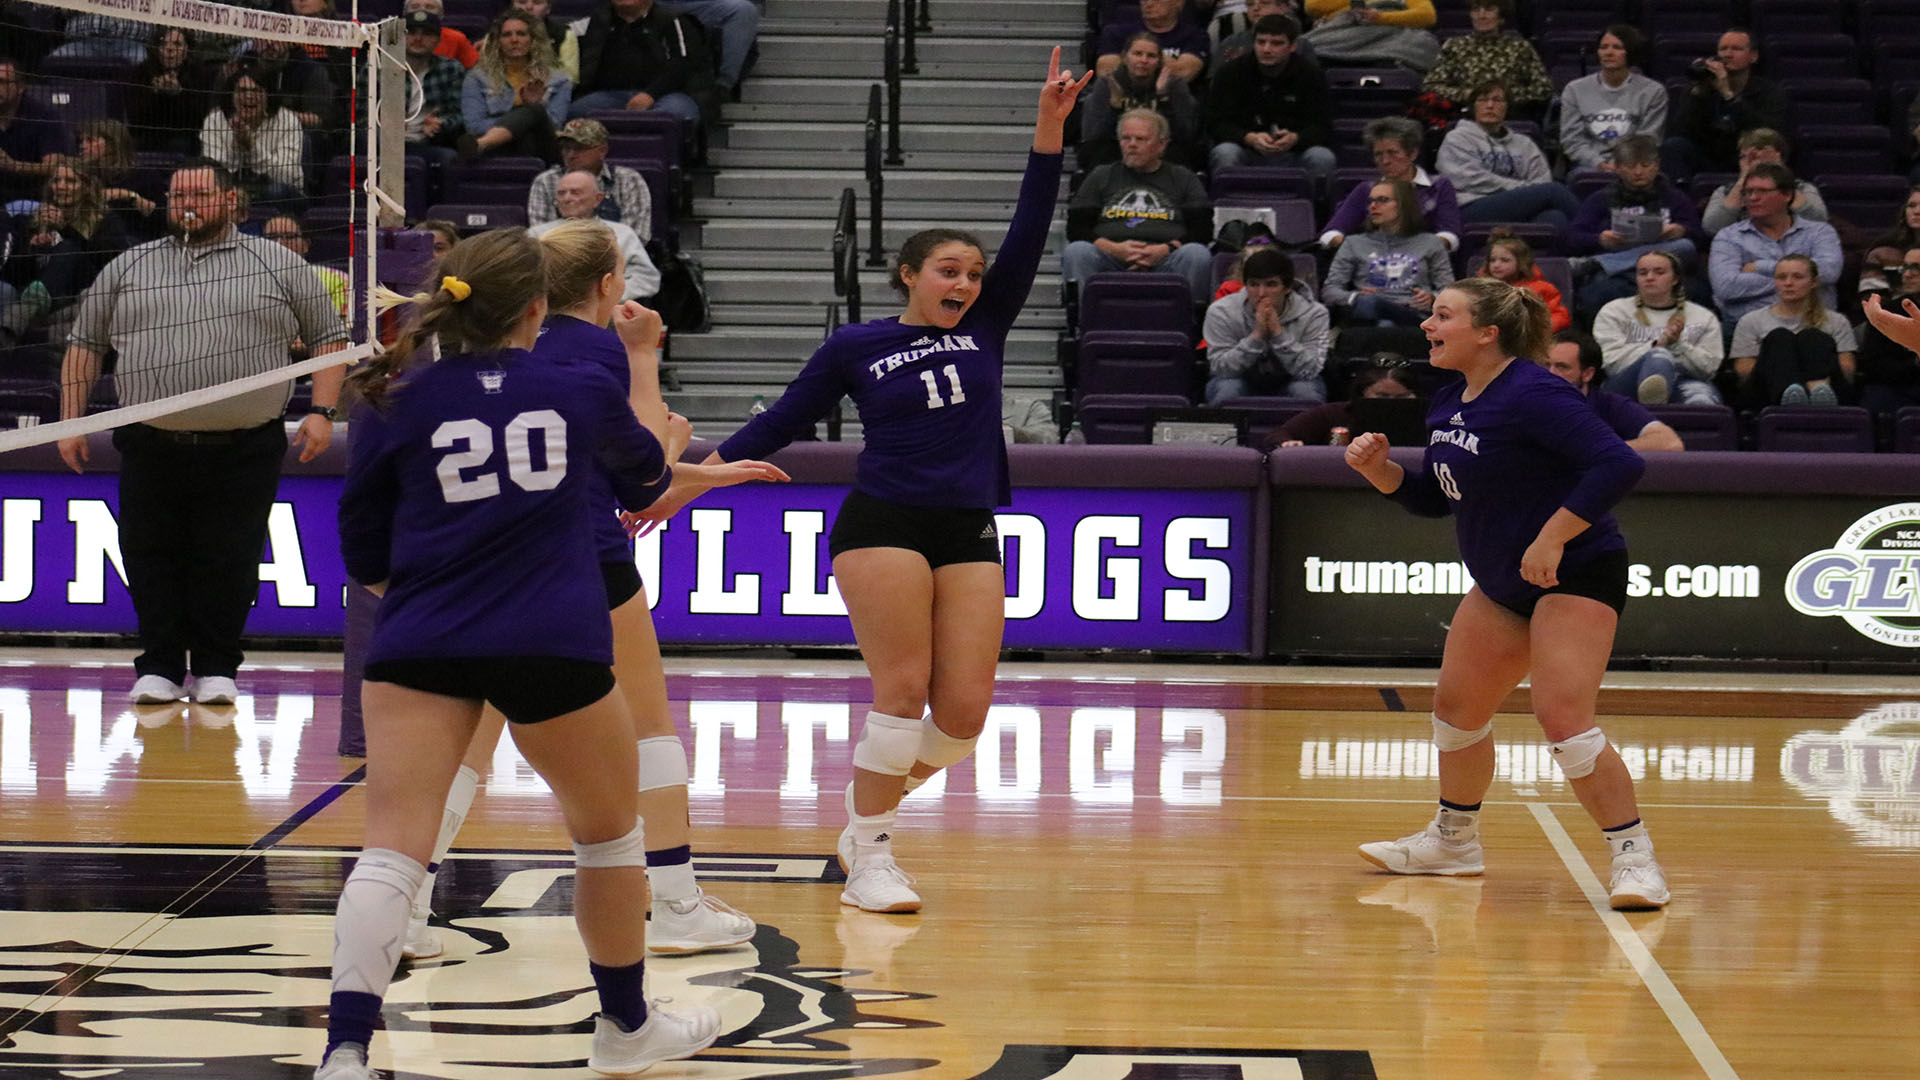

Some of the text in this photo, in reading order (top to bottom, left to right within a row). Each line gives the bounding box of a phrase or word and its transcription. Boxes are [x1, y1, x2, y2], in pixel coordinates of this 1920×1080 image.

[869, 334, 980, 380] TRUMAN
[919, 363, 966, 410] 11
[431, 409, 568, 503] 20
[1430, 429, 1480, 456] RUMAN
[1433, 462, 1462, 501] 10
[1845, 508, 1920, 545] GREAT LAK
[1796, 556, 1920, 609] GL
